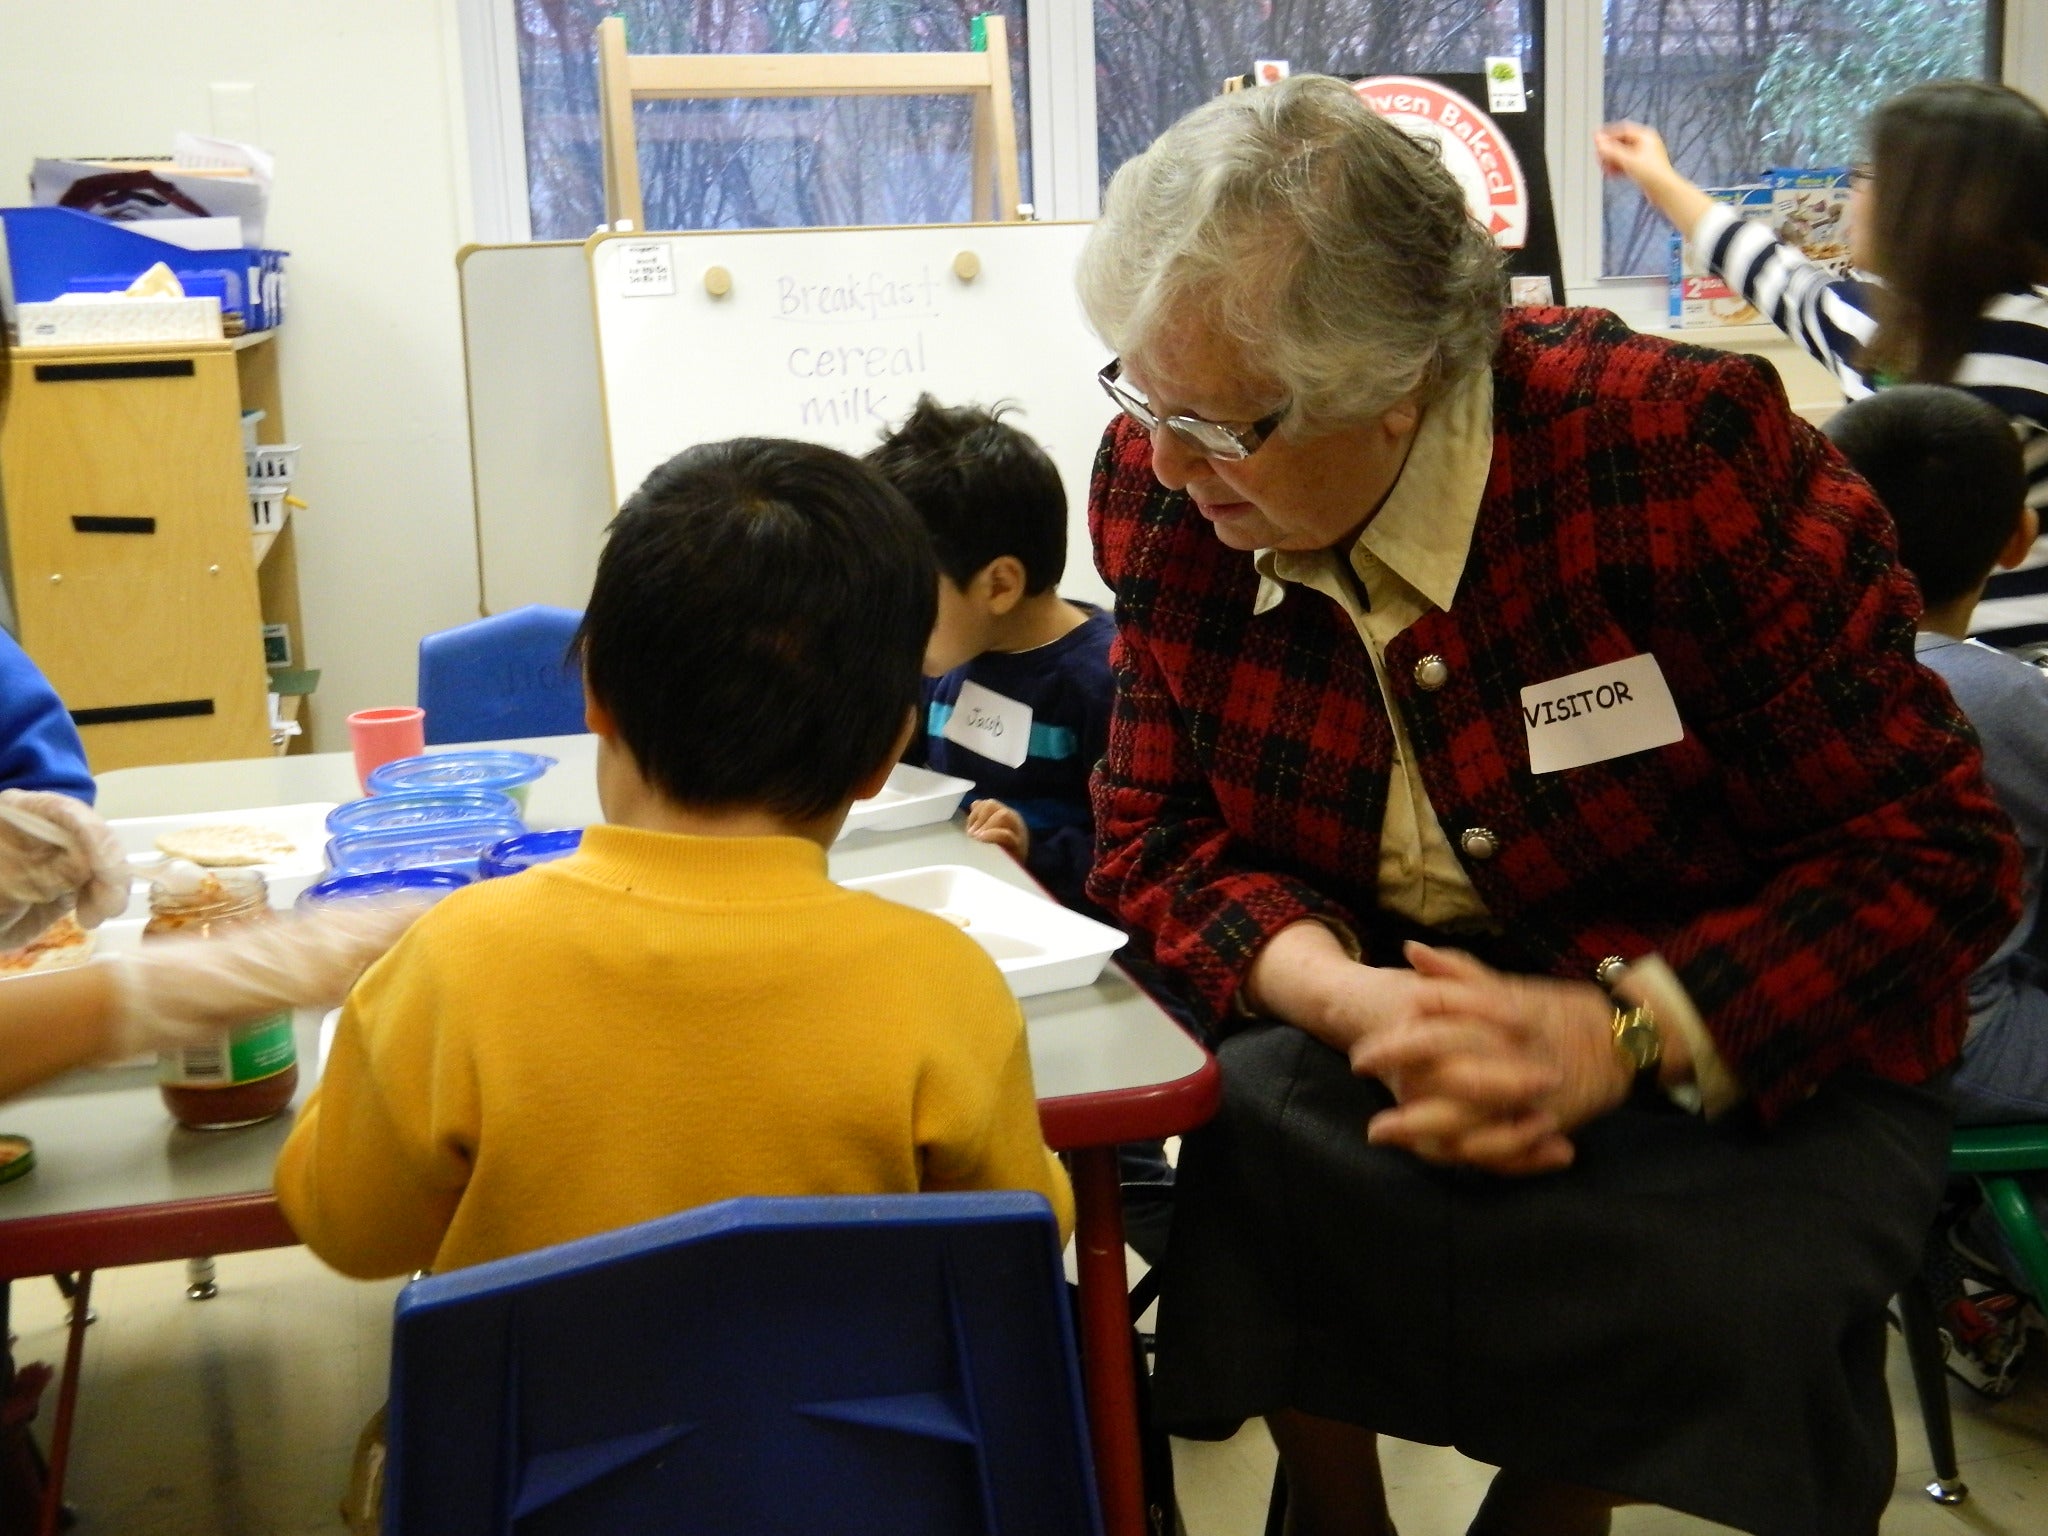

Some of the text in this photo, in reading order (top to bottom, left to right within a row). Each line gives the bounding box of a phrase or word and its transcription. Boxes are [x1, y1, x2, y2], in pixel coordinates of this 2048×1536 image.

[1439, 102, 1513, 194] Baked
[777, 264, 940, 320] Breakfast
[788, 331, 926, 378] cereal
[801, 387, 890, 426] milk
[1522, 681, 1633, 728] VISITOR
